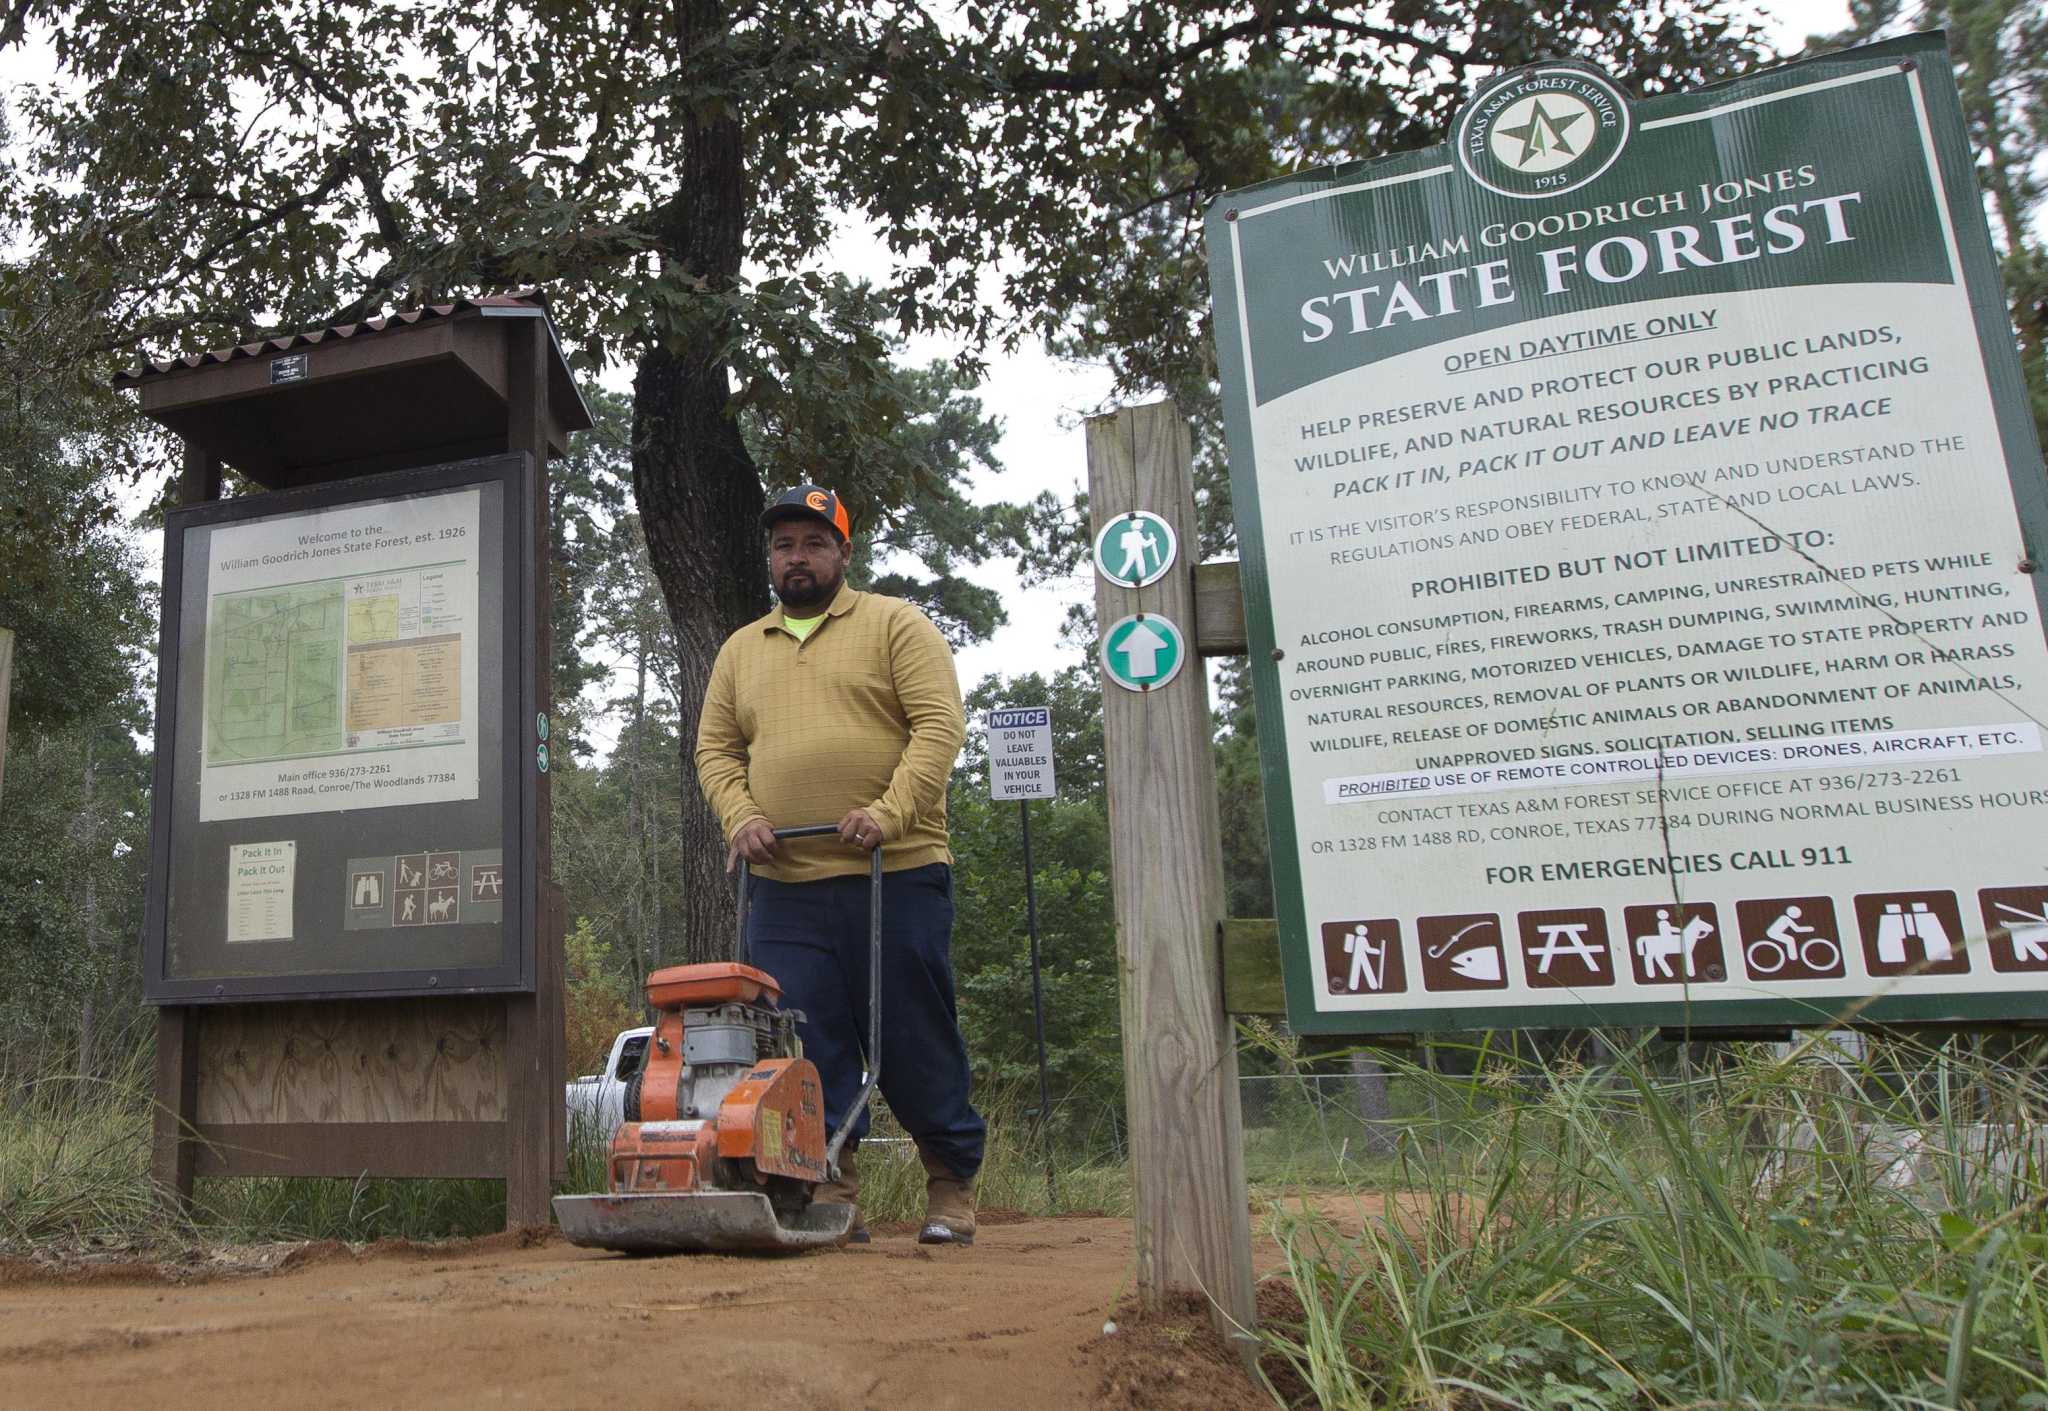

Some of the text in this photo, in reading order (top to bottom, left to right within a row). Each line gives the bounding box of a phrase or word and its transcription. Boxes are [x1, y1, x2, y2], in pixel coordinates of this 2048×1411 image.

[1471, 78, 1617, 158] TEXAS A&M FOREST SERVICE
[1535, 173, 1567, 189] 1915
[1323, 165, 1816, 280] WILLIAM GOODRICH JONES
[1301, 192, 1862, 343] STATE FOREST
[1444, 309, 1718, 373] OPEN DAYTIME ONLY
[1301, 326, 1901, 440] HELP PRESERVE AND PROTECT OUR PUBLIC LANDS,
[1294, 357, 1928, 472] WILDLIFE, AND NATURAL RESOURCES BY PRACTICING
[1334, 397, 1891, 498] PACK IT IN, PACK IT OUT AND LEAVE NO TRACE
[1290, 531, 1304, 545] IT
[1309, 525, 1323, 542] IS
[1328, 523, 1361, 540] THE
[1456, 485, 1602, 519] RESPONSIBILITY
[1609, 481, 1636, 497] TO
[1642, 470, 1706, 492] KNOW
[1714, 463, 1759, 482] AND
[1766, 443, 1915, 474] UNDERSTAND
[1920, 435, 1965, 454] THE
[221, 526, 466, 571] William Goodrich Jones State Forest, est. 1926
[297, 525, 383, 546] Welcome to the
[1412, 530, 1835, 598] PROHIBITED BUT NOT LIMITED TO:
[1300, 552, 1992, 647] ALCOHOL CONSUMPTION, FIREARMS, CAMPING, UNRESTRAINED PETS WHILE
[1296, 582, 2009, 674] AROUND PUBLIC, FIRES, FIREWORKS, TRASH DUMPING, SWIMMING, HUNTING,
[991, 711, 1045, 727] NOTICE
[1003, 730, 1036, 740] DO NOT
[1310, 675, 2022, 752] WILDLIFE, RELEASE OF DOMESTIC ANIMALS OR ABANDONMENT OF ANIMALS,
[995, 756, 1047, 768] VALUABLES
[1007, 744, 1035, 753] LEAVE
[1339, 732, 2023, 797] PROHIBITED USE OF REMOTE CONTROLLED DEVICES: DRONES, AIRCRAFT, ETC.
[1416, 748, 1535, 770] UNAPPROVED
[1746, 722, 1825, 741] SELLING
[1831, 716, 1894, 734] ITEMS
[218, 793, 229, 802] or
[230, 790, 251, 801] 1328
[252, 788, 267, 799] FM
[269, 786, 290, 798] 1488
[318, 779, 371, 794] Conroe/The
[374, 775, 425, 789] Woodlands
[428, 772, 456, 784] 77384
[278, 764, 391, 783] Main office 936/273-2261
[1004, 770, 1040, 781] IN YOUR
[1004, 784, 1042, 794] VEHICLE
[1378, 768, 1961, 824] CONTACT TEXAS A&M FOREST SERVICE OFFICE AT 936/273-2261
[1311, 841, 1334, 854] OR
[1339, 837, 1377, 852] 1328
[1381, 835, 1406, 848] FM
[1413, 831, 1452, 846] 1488
[1457, 829, 1485, 844] RD,
[1490, 823, 1570, 840] CONROE,
[1573, 818, 1630, 834] TEXAS
[1634, 814, 1692, 835] 77384
[1697, 808, 1774, 826] DURING
[1780, 802, 1870, 821] NORMAL
[1875, 795, 1973, 815] BUSINESS
[238, 867, 258, 876] Pack
[269, 865, 285, 874] Out
[242, 848, 261, 857] Pack
[1486, 846, 1852, 885] FOR EMERGENCIES CALL 911
